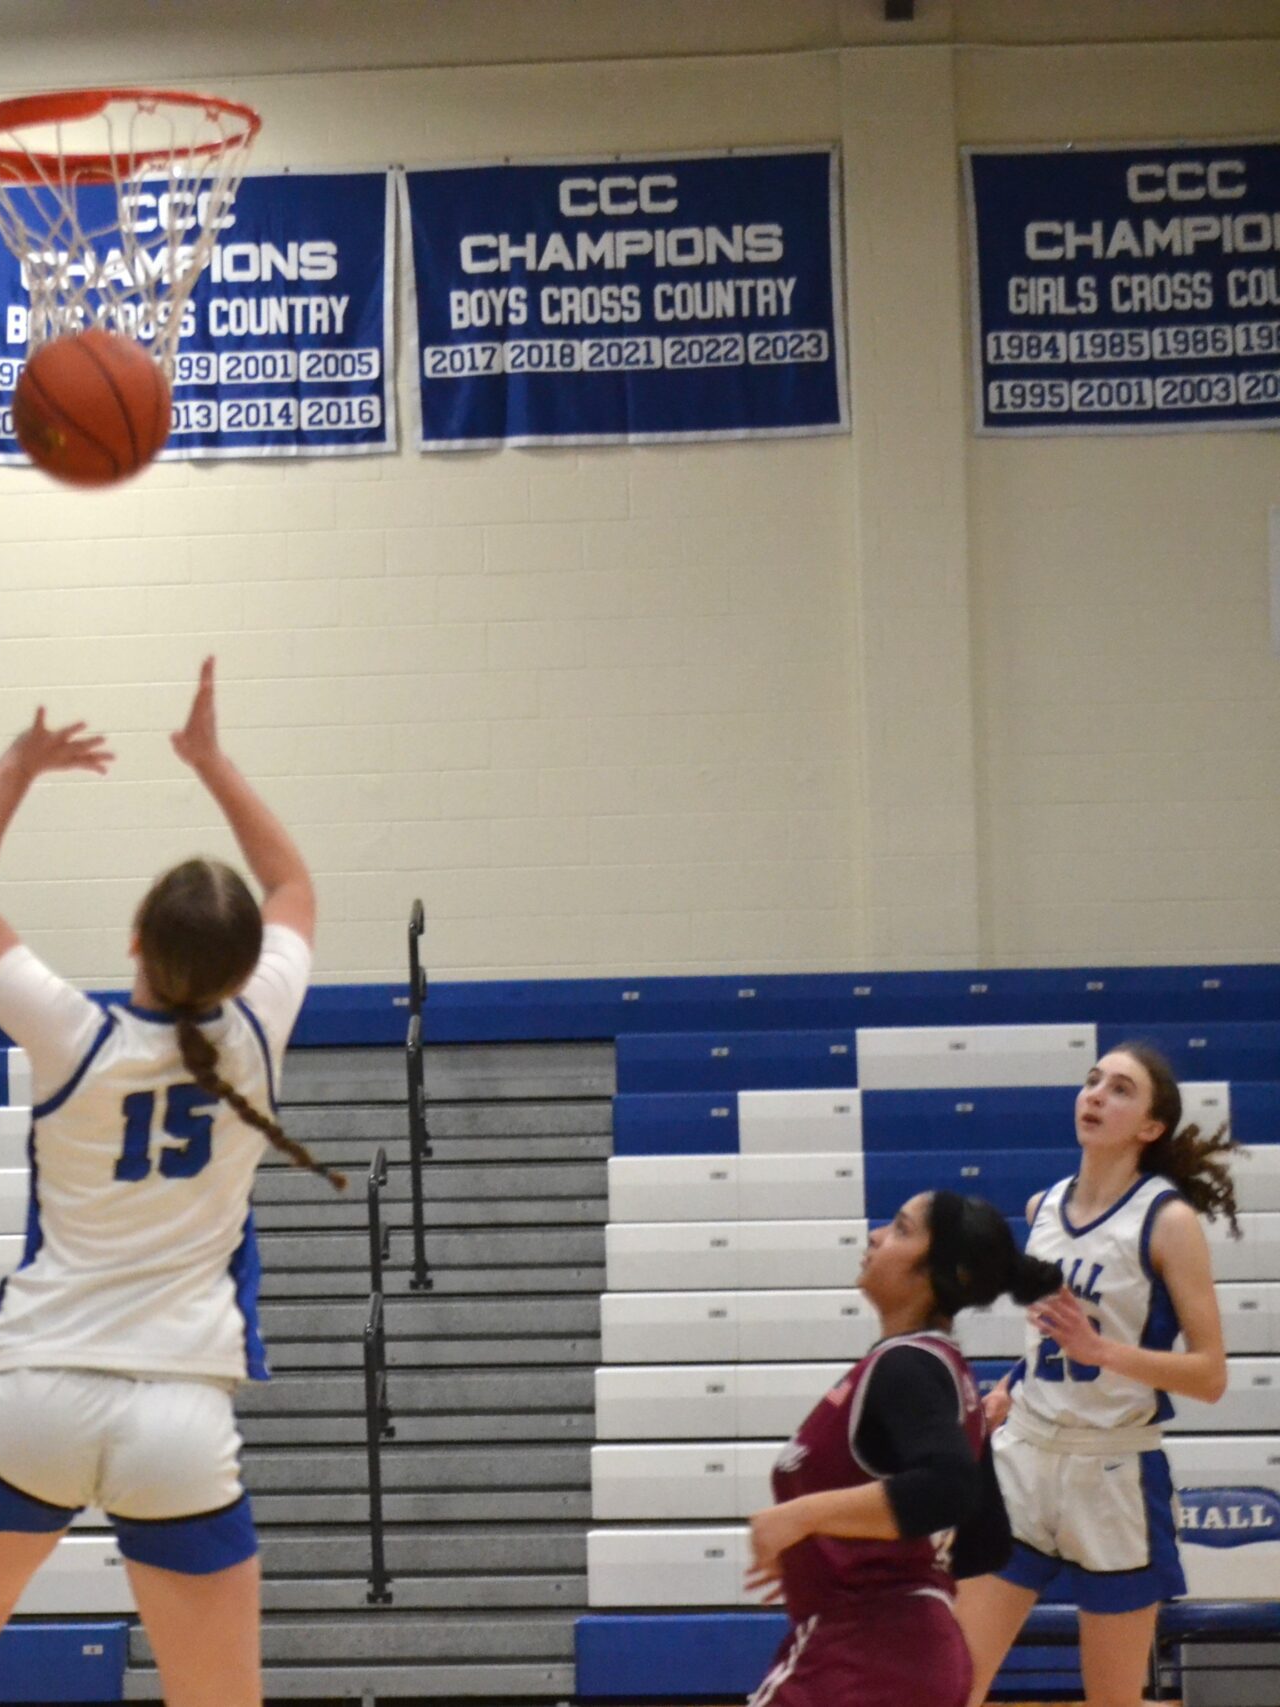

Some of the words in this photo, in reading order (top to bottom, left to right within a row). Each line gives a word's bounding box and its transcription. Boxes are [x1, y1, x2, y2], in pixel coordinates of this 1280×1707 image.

[559, 174, 678, 218] CCC
[1126, 160, 1247, 203] CCC
[122, 191, 236, 233] CCC
[460, 224, 783, 274] CHAMPIONS
[1025, 213, 1280, 261] CHAMPIO
[21, 242, 338, 291] CHAMPIONS
[450, 287, 528, 330] BOYS
[541, 285, 641, 325] CROSS
[655, 276, 797, 322] COUNTRY
[1008, 275, 1099, 315] GIRLS
[1111, 271, 1213, 313] CROSS
[209, 296, 349, 336] COUNTRY
[226, 354, 292, 380] 2001
[306, 351, 373, 377] 2005
[431, 346, 498, 374] 2017
[510, 343, 577, 369] 2018
[588, 341, 657, 368] 2021
[670, 338, 741, 365] 2022
[754, 334, 822, 360] 2023
[992, 334, 1061, 361] 1984
[1075, 331, 1145, 359] 1985
[1160, 328, 1228, 355] 1986
[226, 402, 293, 428] 2014
[310, 399, 374, 426] 2016
[994, 382, 1065, 410] 1995
[1077, 380, 1147, 407] 2001
[1162, 376, 1231, 404] 2003
[114, 1083, 220, 1182] 15
[1179, 1504, 1273, 1530] HALL
